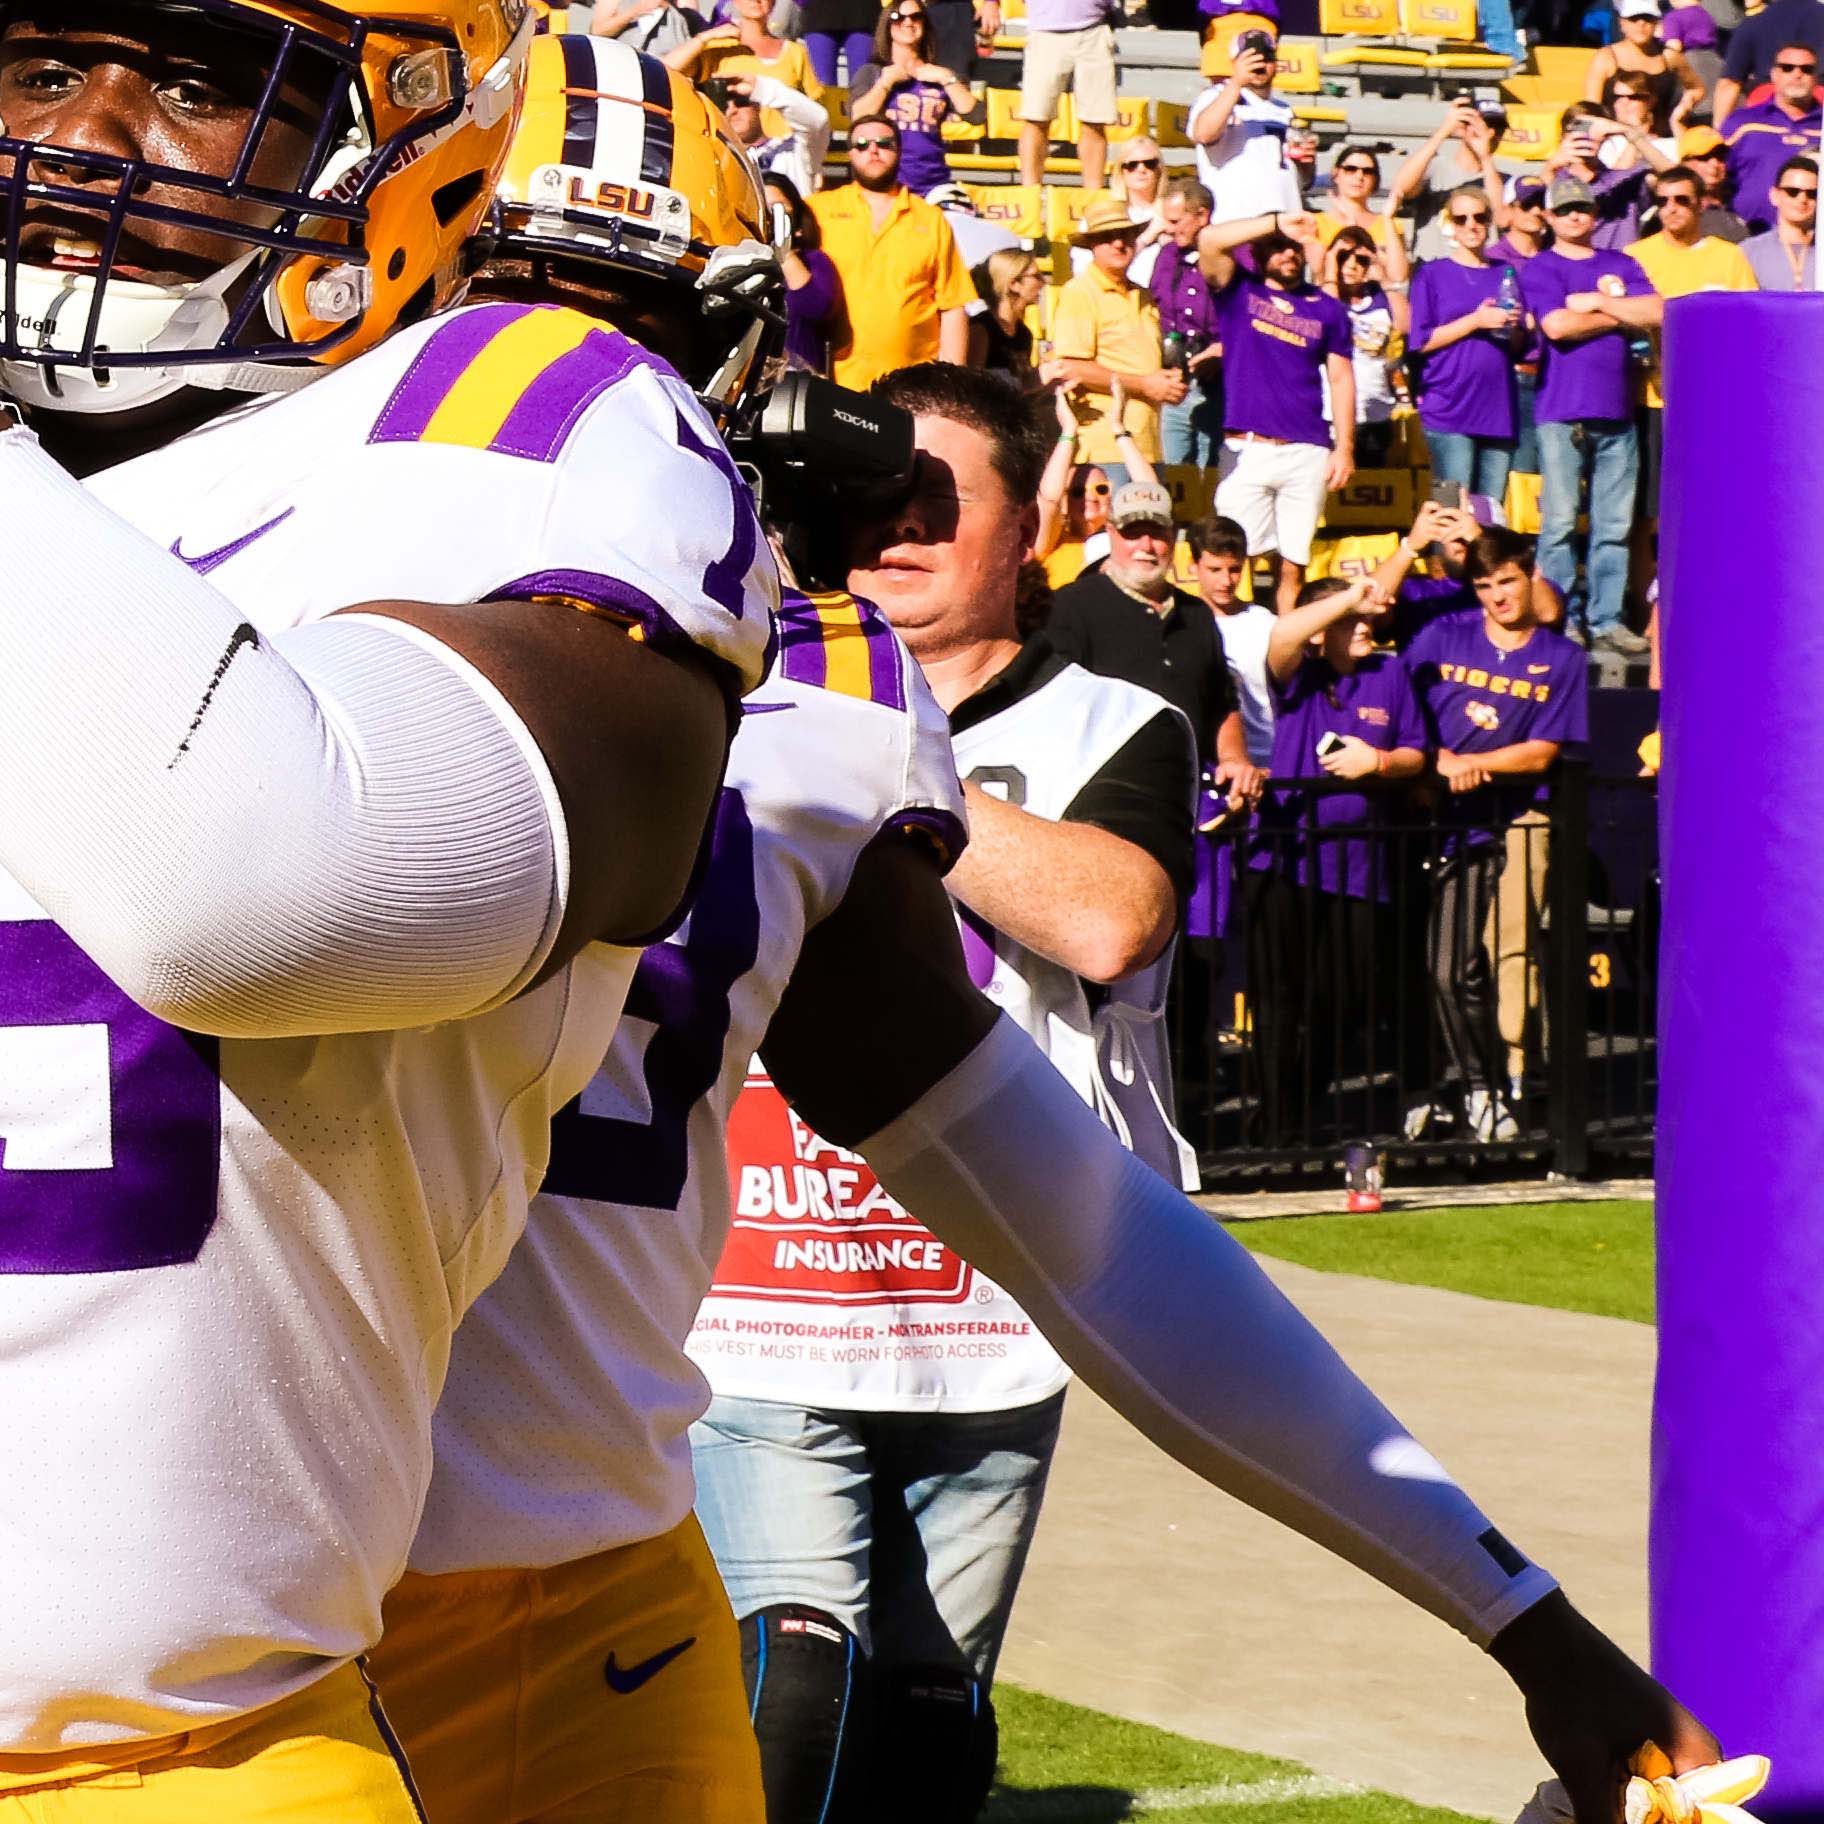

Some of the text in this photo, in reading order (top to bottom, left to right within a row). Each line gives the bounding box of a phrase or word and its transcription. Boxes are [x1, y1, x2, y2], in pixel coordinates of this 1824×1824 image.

[1340, 5, 1382, 19] LSU
[1418, 5, 1460, 21] LSU
[568, 177, 656, 220] LSU
[1119, 489, 1162, 506] LSU
[1339, 487, 1394, 506] LSU
[1440, 665, 1548, 702] TIGERS
[1590, 954, 1610, 988] 3
[775, 1241, 944, 1271] INSURANCE
[736, 1319, 875, 1340] PHOTOGRAPHER
[717, 1341, 754, 1358] VEST
[759, 1343, 804, 1359] MUST
[809, 1346, 827, 1361] BE
[833, 1346, 878, 1362] WORN
[947, 1343, 1006, 1358] ACCESS
